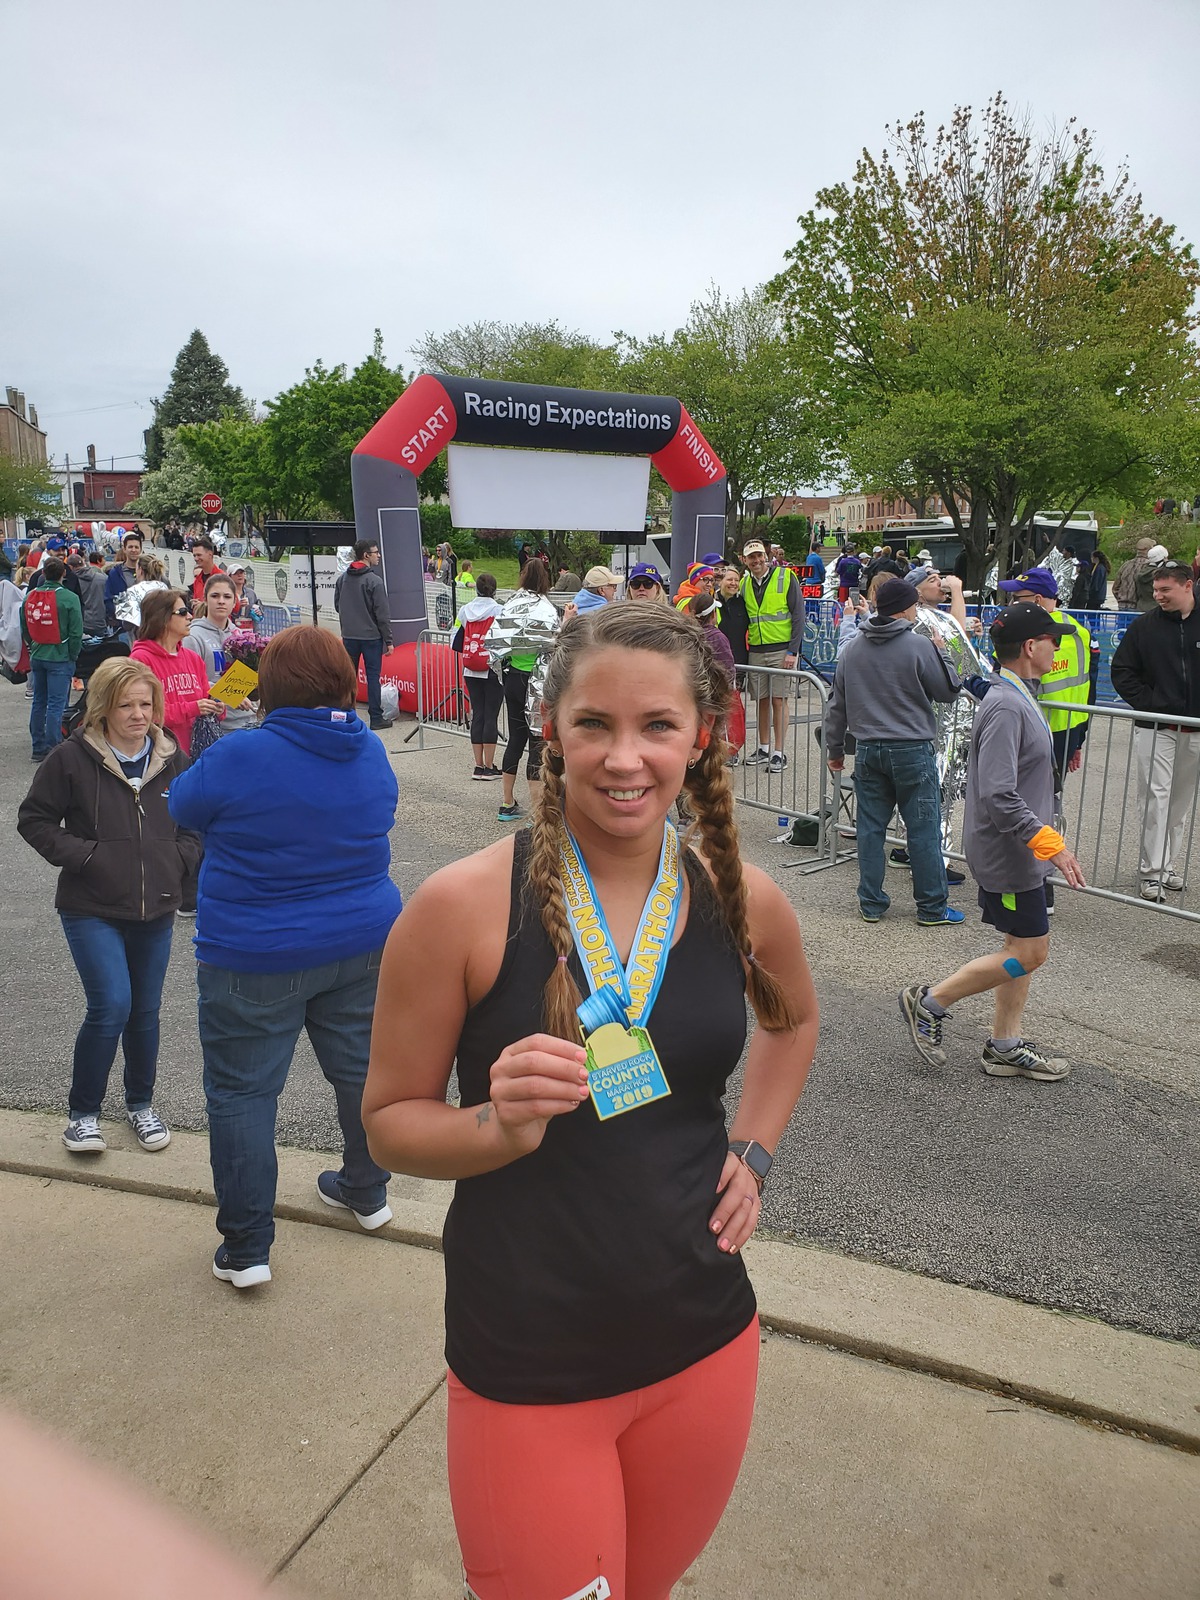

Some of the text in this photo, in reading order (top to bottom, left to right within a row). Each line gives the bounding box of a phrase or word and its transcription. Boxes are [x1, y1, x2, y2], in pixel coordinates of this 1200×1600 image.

[463, 391, 673, 431] Racing Expectations
[400, 404, 450, 465] START
[679, 423, 719, 480] FINISH
[202, 499, 221, 508] STOP
[591, 1053, 652, 1081] STARVED ROCK
[592, 1059, 656, 1093] COUNTRY
[606, 1075, 651, 1098] MARATHON
[611, 1084, 653, 1110] 2019
